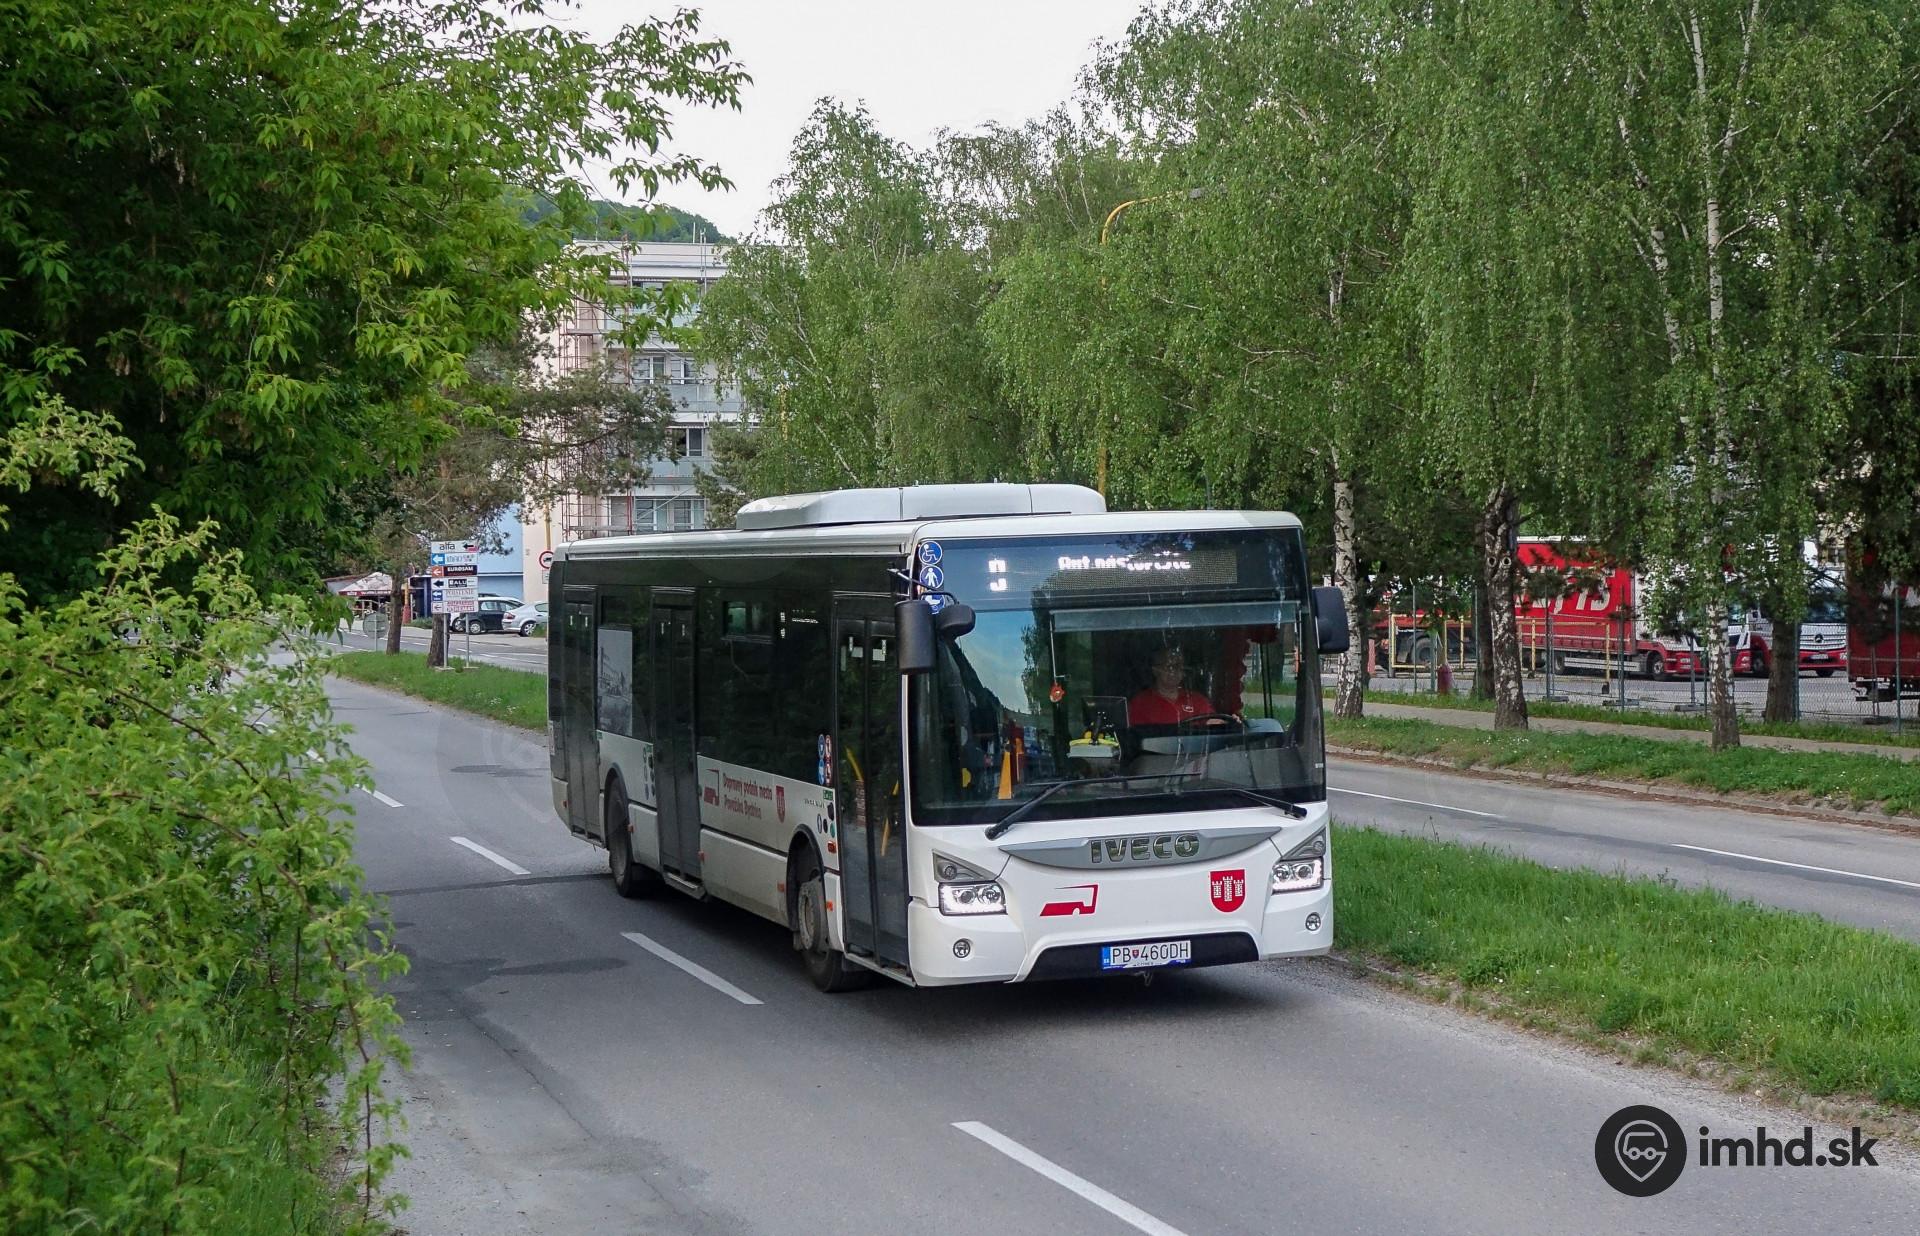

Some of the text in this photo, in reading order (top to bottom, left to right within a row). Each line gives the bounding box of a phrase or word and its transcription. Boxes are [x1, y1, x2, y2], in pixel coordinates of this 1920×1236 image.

[439, 541, 456, 551] alfa
[743, 778, 758, 797] podnik
[758, 784, 773, 801] mesta
[1090, 834, 1200, 863] IVECO
